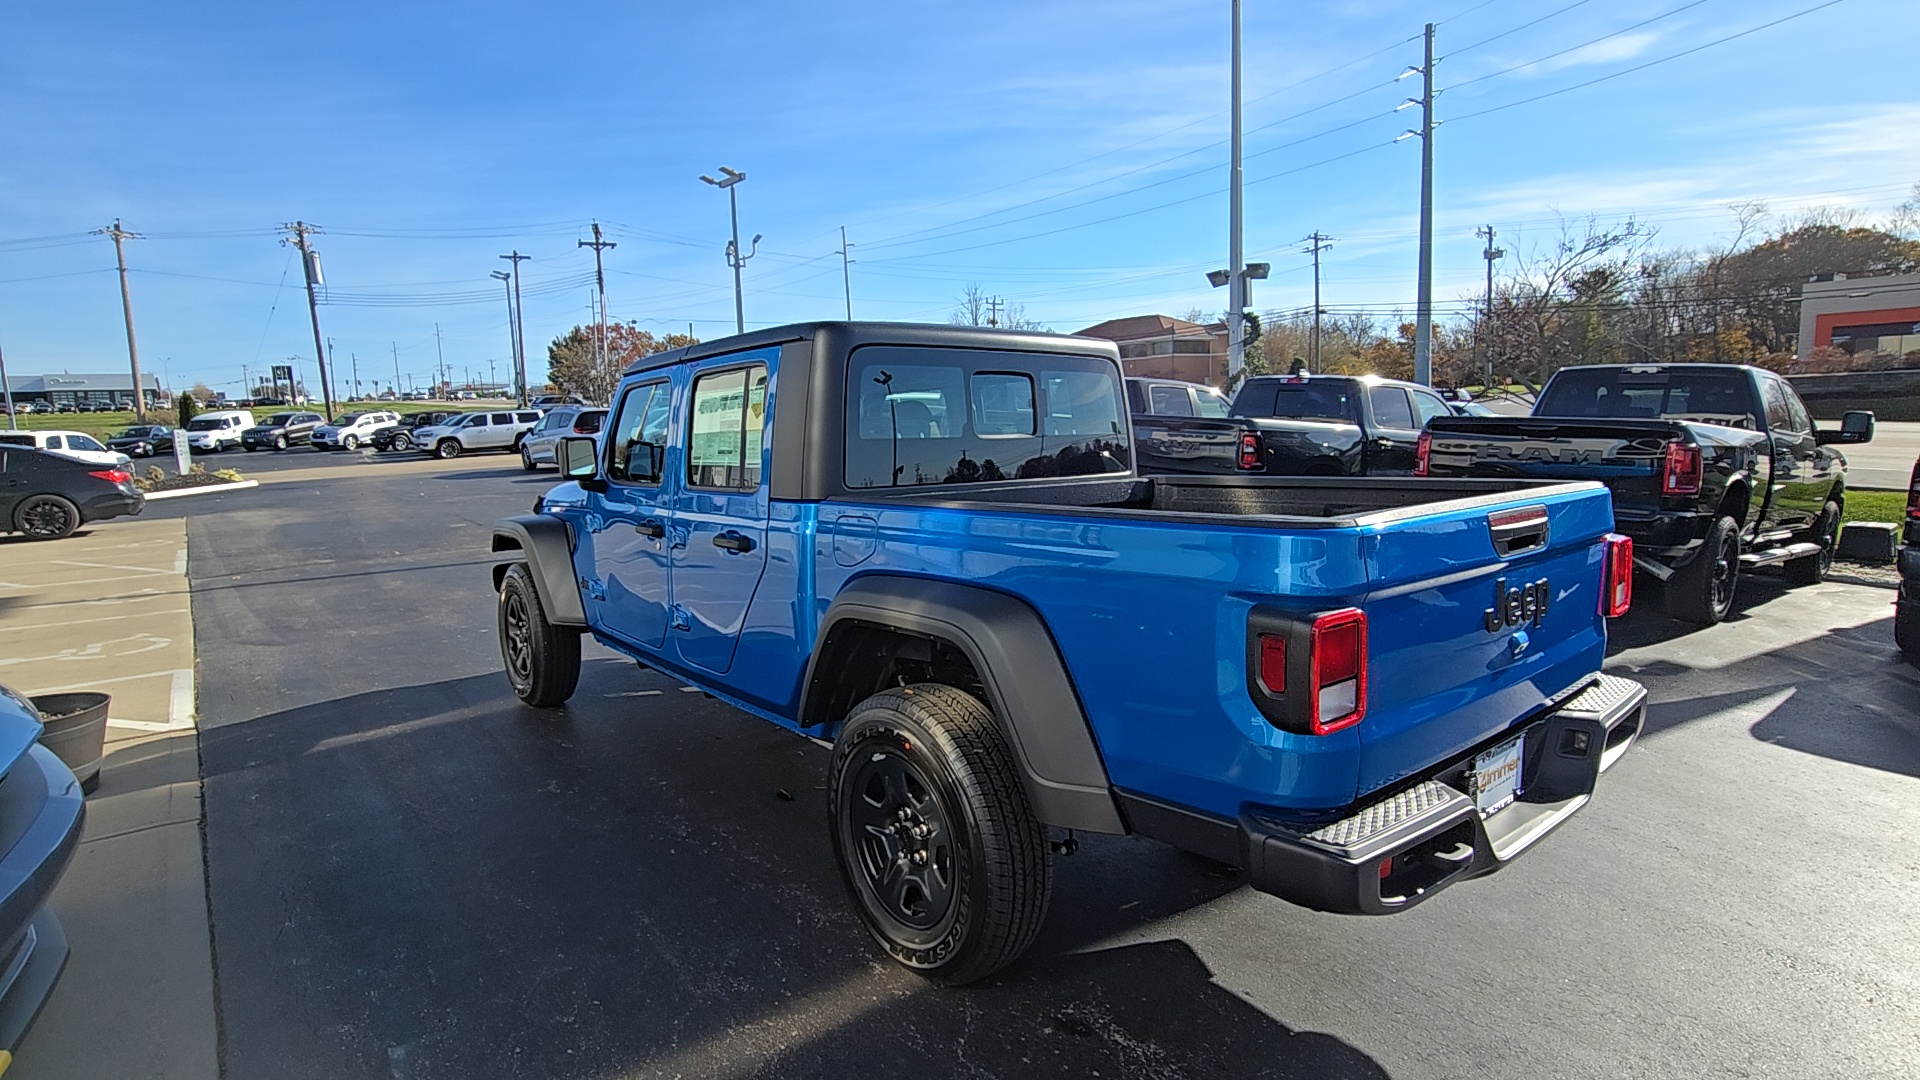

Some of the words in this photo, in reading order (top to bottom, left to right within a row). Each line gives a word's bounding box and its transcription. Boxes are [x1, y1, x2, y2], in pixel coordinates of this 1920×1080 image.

[1476, 446, 1603, 464] RAM
[1484, 577, 1550, 633] Jeep
[1478, 756, 1521, 794] Zimmer
